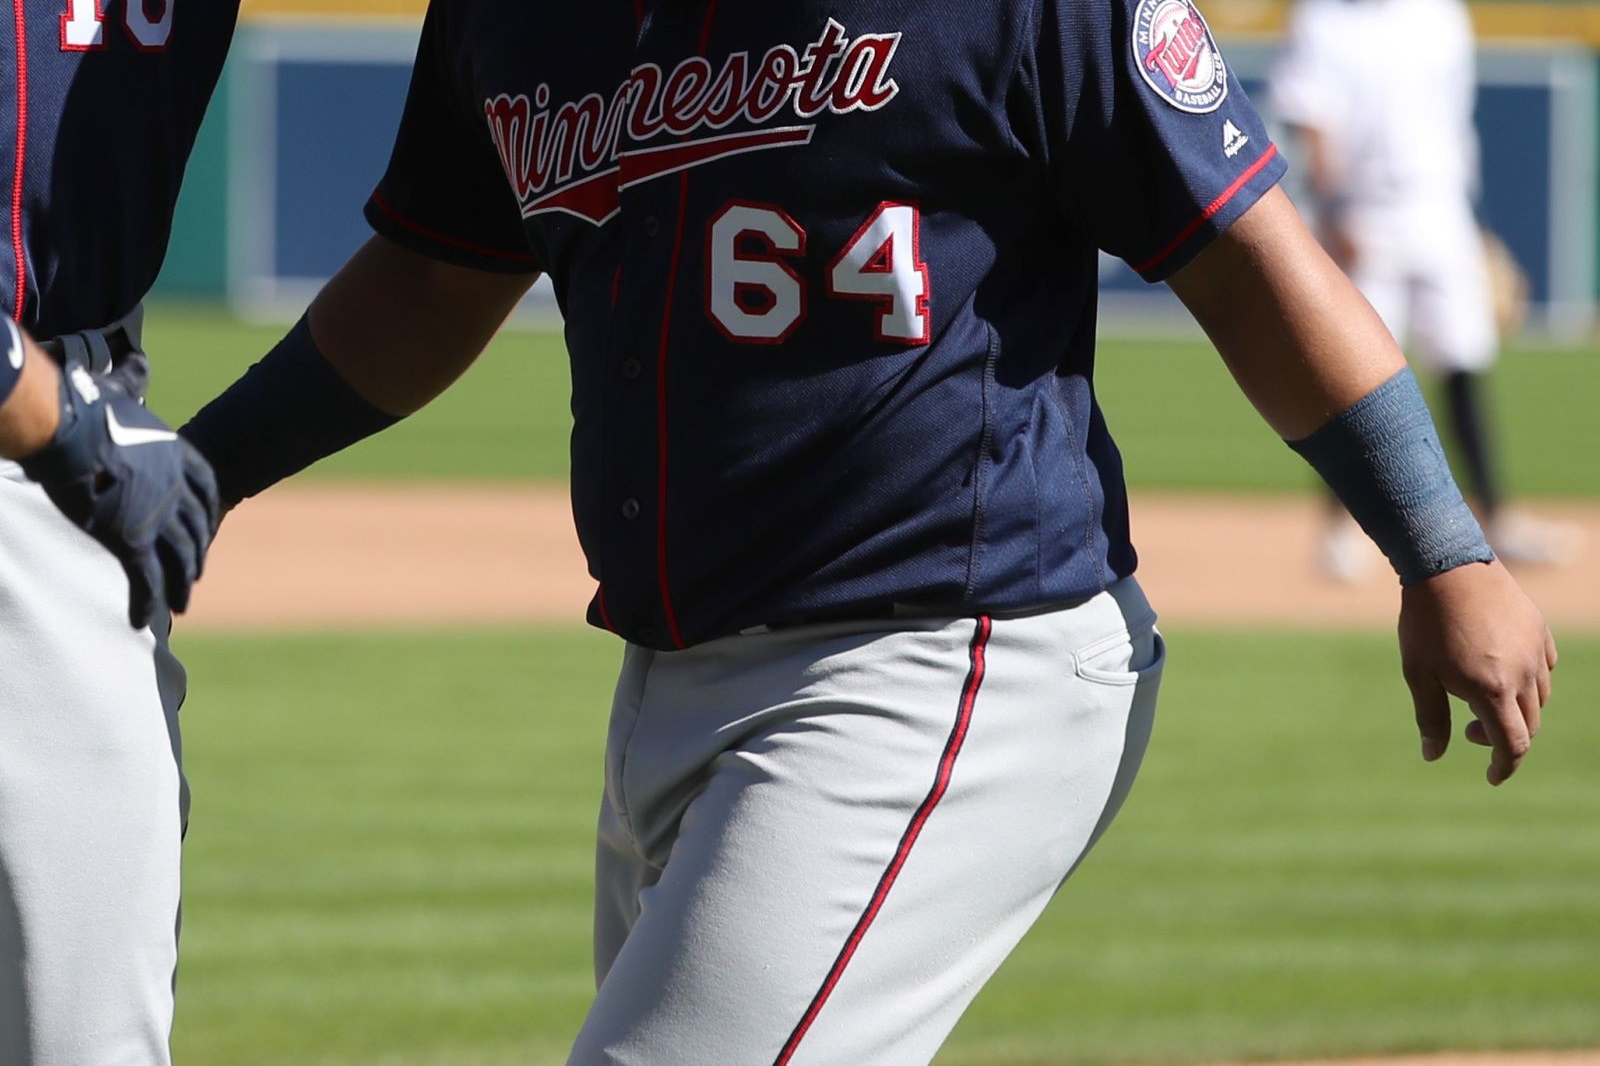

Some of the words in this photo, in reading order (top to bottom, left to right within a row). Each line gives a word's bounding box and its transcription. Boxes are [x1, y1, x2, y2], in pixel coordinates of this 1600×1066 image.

[1144, 6, 1206, 89] Twins
[1175, 83, 1222, 105] BASEBALL
[484, 16, 902, 202] Minnesota
[705, 198, 931, 345] 64
